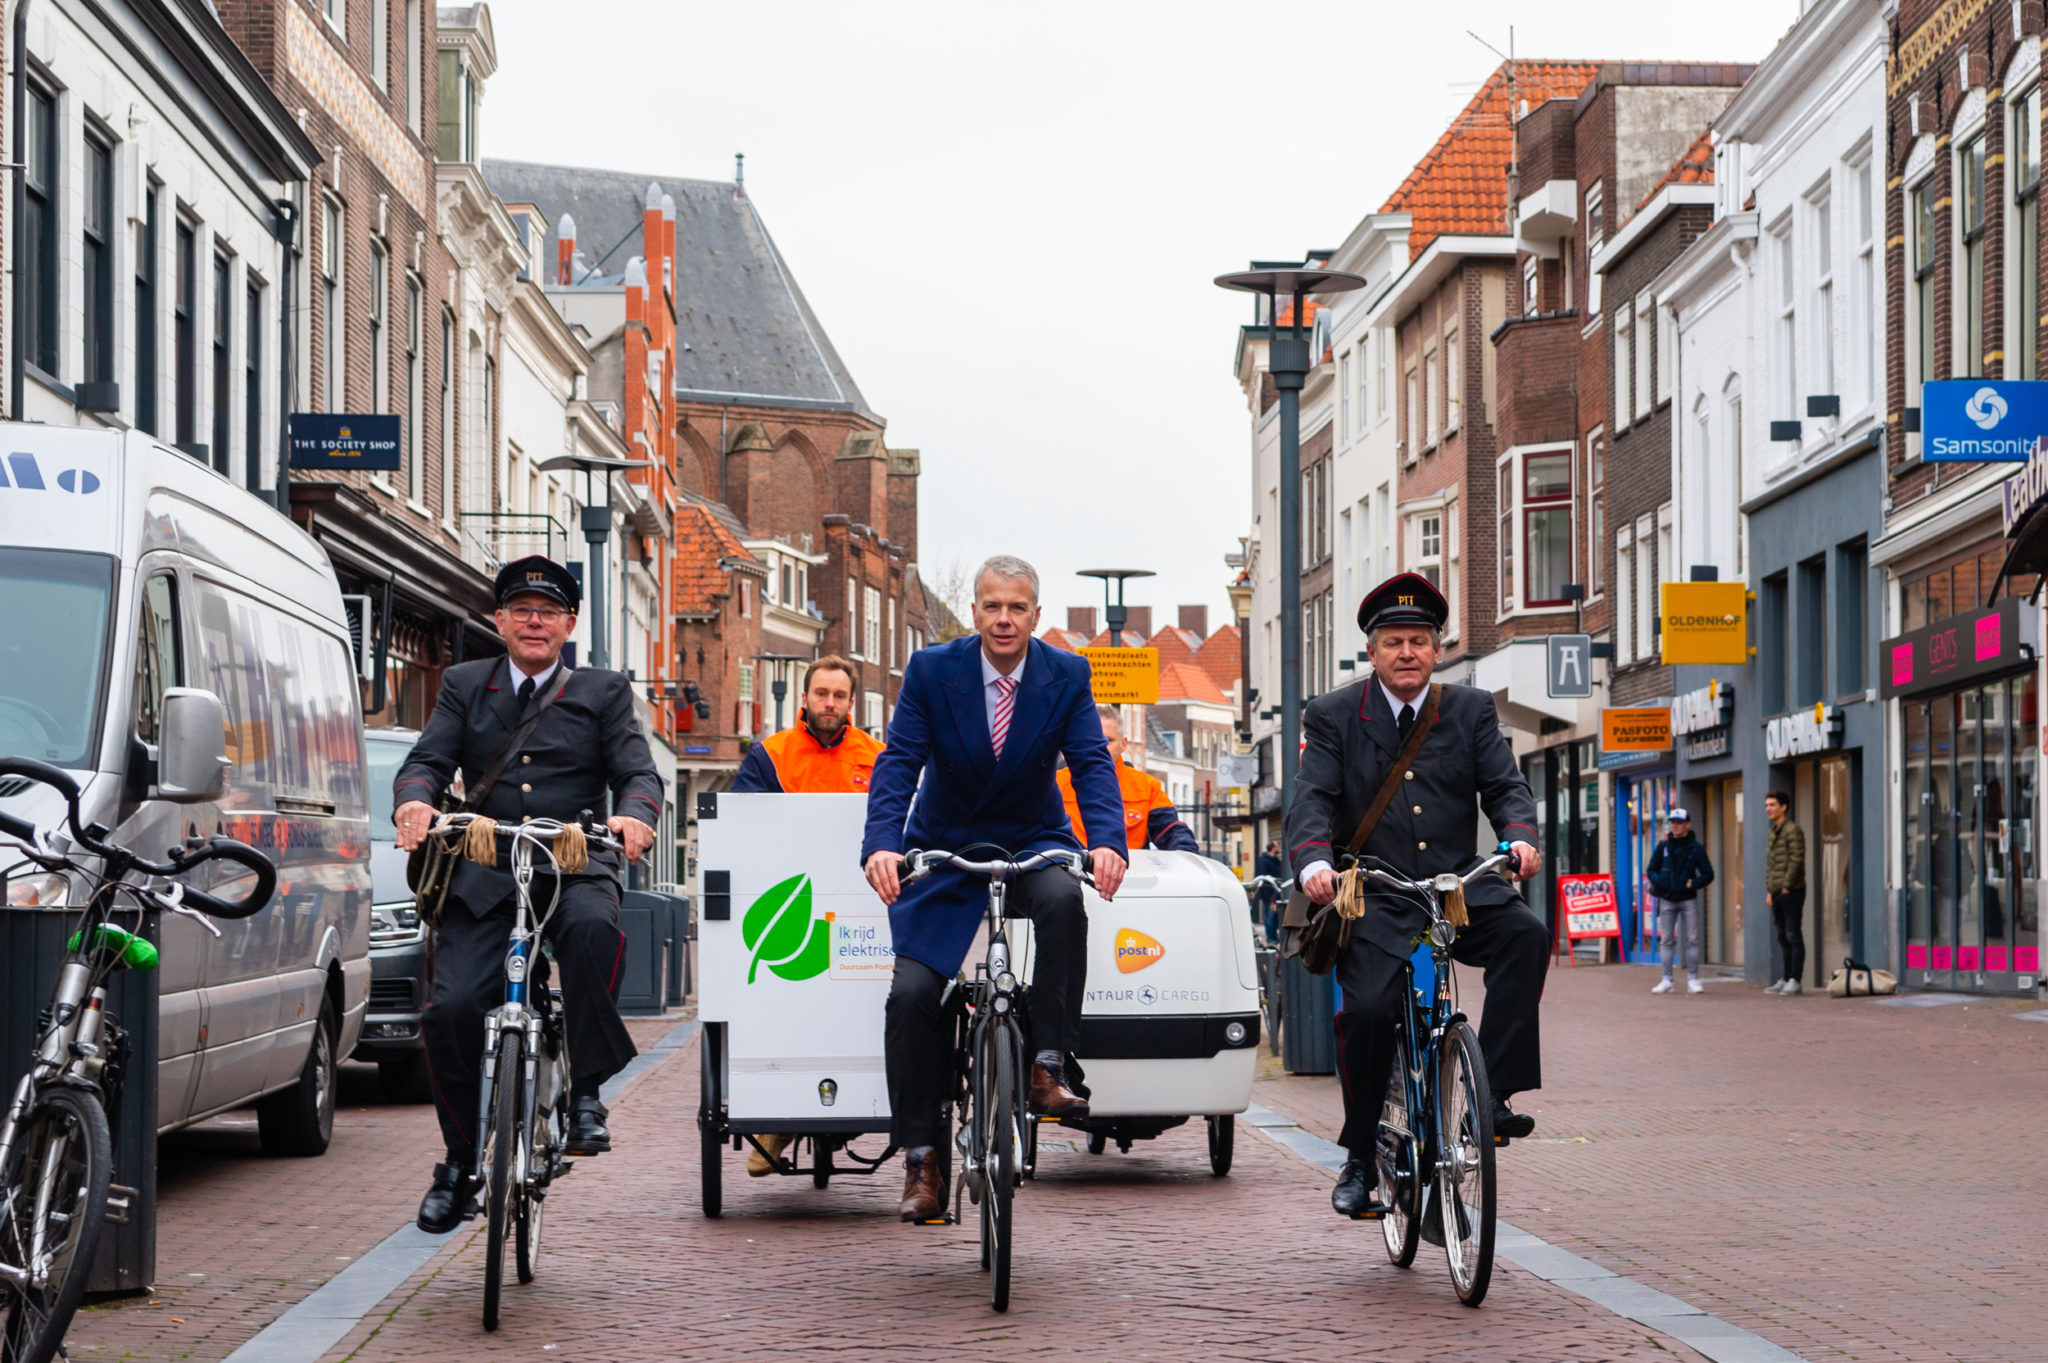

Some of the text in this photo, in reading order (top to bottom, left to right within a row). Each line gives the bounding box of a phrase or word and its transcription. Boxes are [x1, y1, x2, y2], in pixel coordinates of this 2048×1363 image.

[294, 440, 396, 450] THE SOCIETY SHOP
[1398, 595, 1414, 606] PTT
[1929, 628, 1957, 665] GENTS
[1613, 725, 1669, 736] PASFOTO
[839, 926, 875, 942] Ik rijd
[1118, 945, 1160, 958] postnl
[1086, 991, 1209, 1002] NTAUR CARGO
